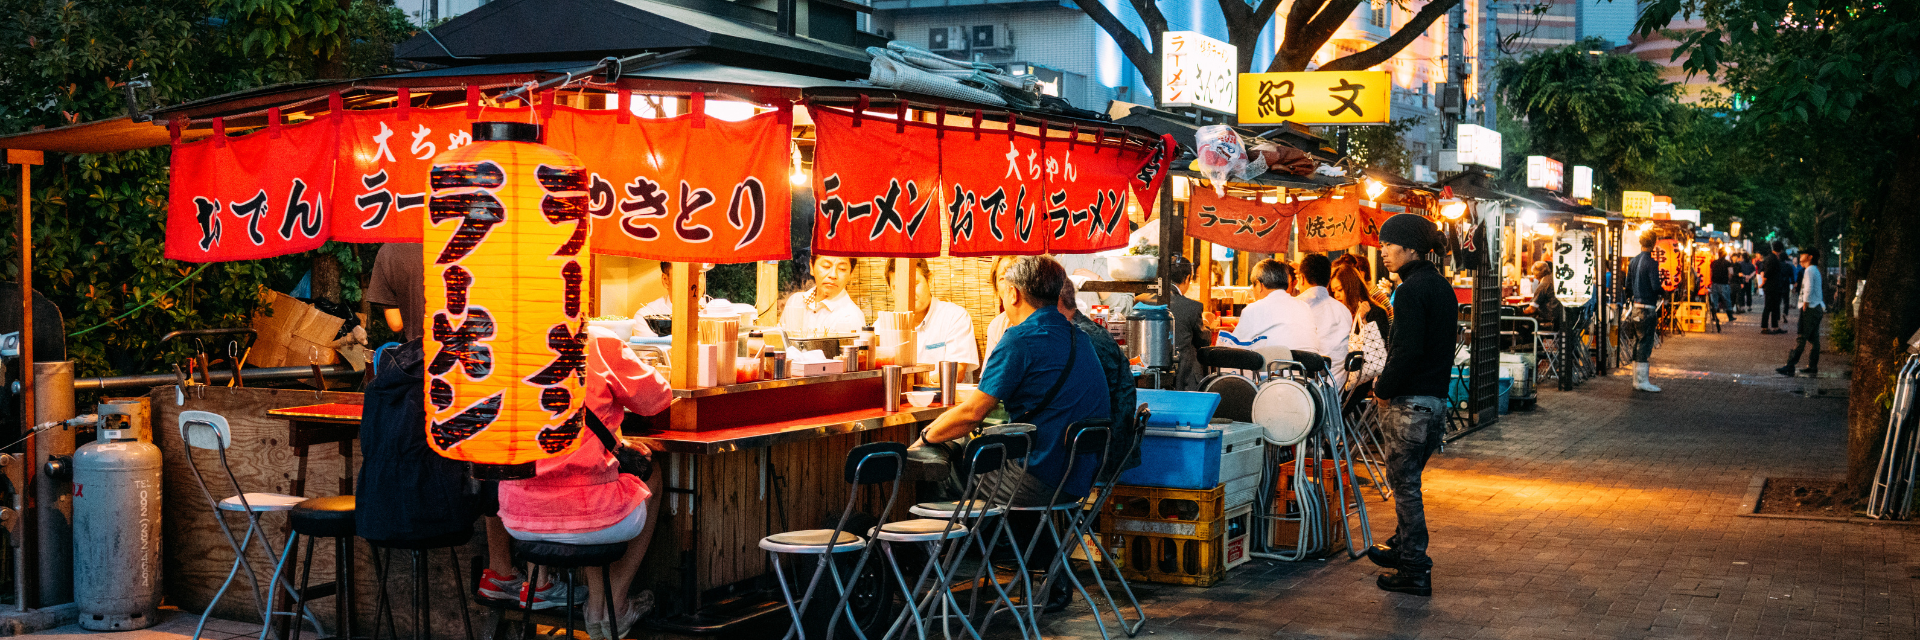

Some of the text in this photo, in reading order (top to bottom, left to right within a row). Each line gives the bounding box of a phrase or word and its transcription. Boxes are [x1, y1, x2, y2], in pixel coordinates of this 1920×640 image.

[1168, 35, 1185, 102] ラーメン
[1258, 78, 1365, 118] 紀文
[1005, 140, 1077, 183] 大ちゃん
[193, 178, 324, 252] おでん
[820, 172, 939, 241] ラーメン
[948, 183, 1126, 244] おでん ラーメン
[1198, 205, 1280, 238] ラーメン
[1306, 211, 1357, 239] 焼ラーメン
[427, 160, 507, 452] ラーメン
